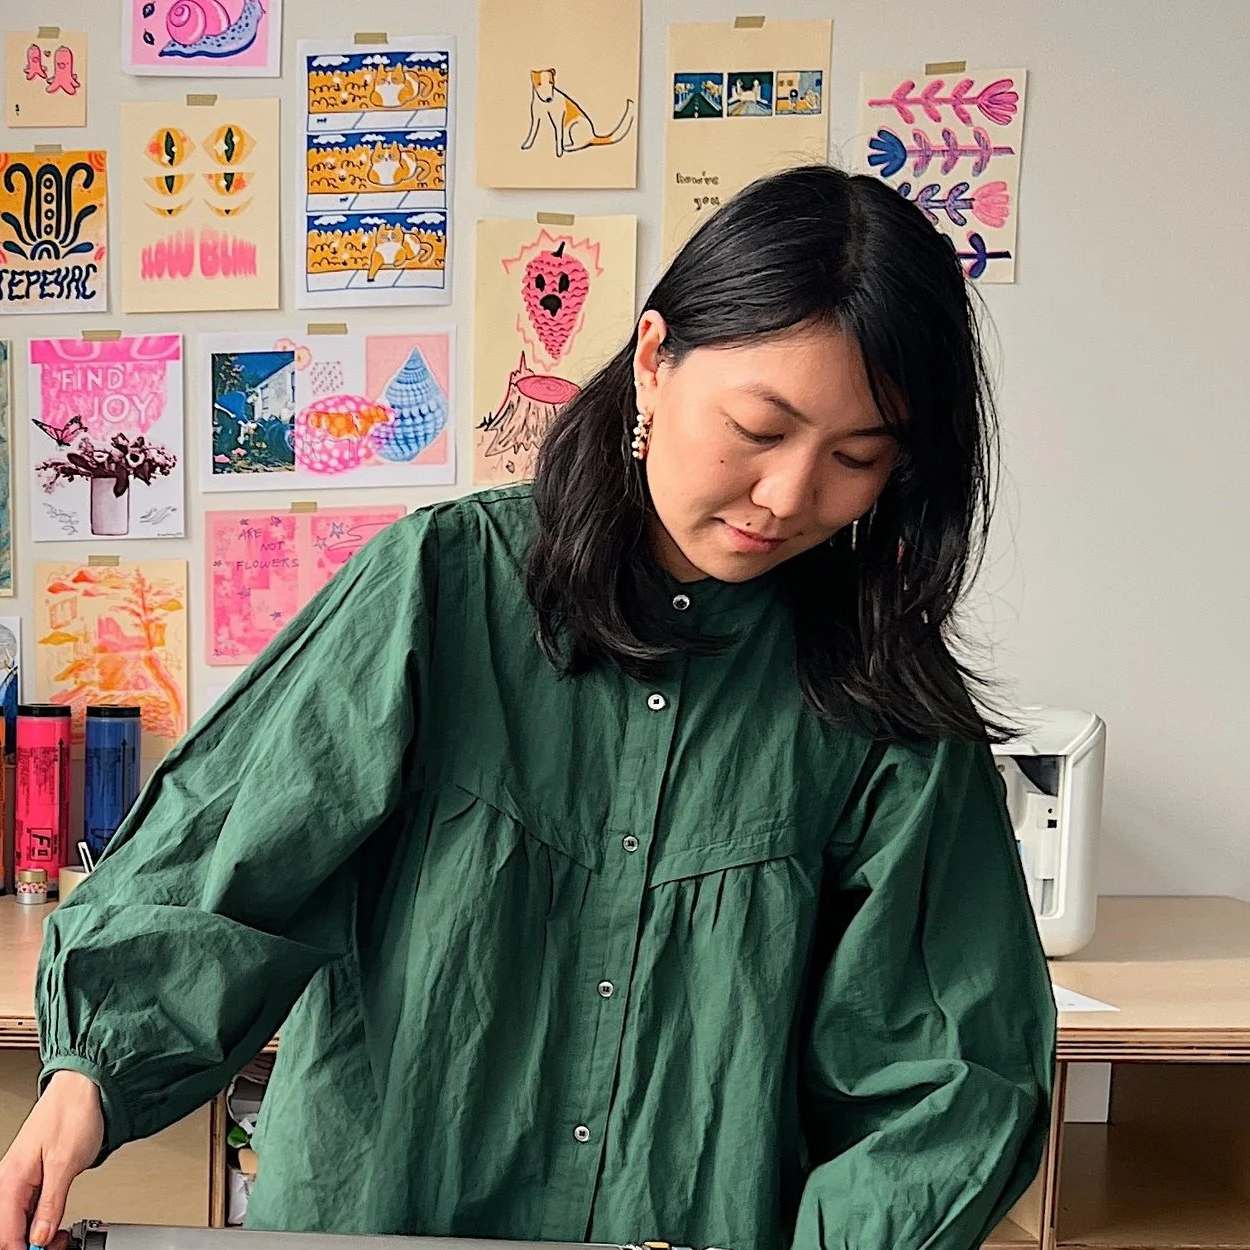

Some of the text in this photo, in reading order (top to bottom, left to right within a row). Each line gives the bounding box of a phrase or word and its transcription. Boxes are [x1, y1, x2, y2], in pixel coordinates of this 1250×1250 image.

[61, 366, 125, 391] FIND
[86, 393, 154, 425] JOY
[237, 528, 263, 541] ARE
[260, 541, 286, 551] NOT
[236, 557, 300, 571] FLOWERS
